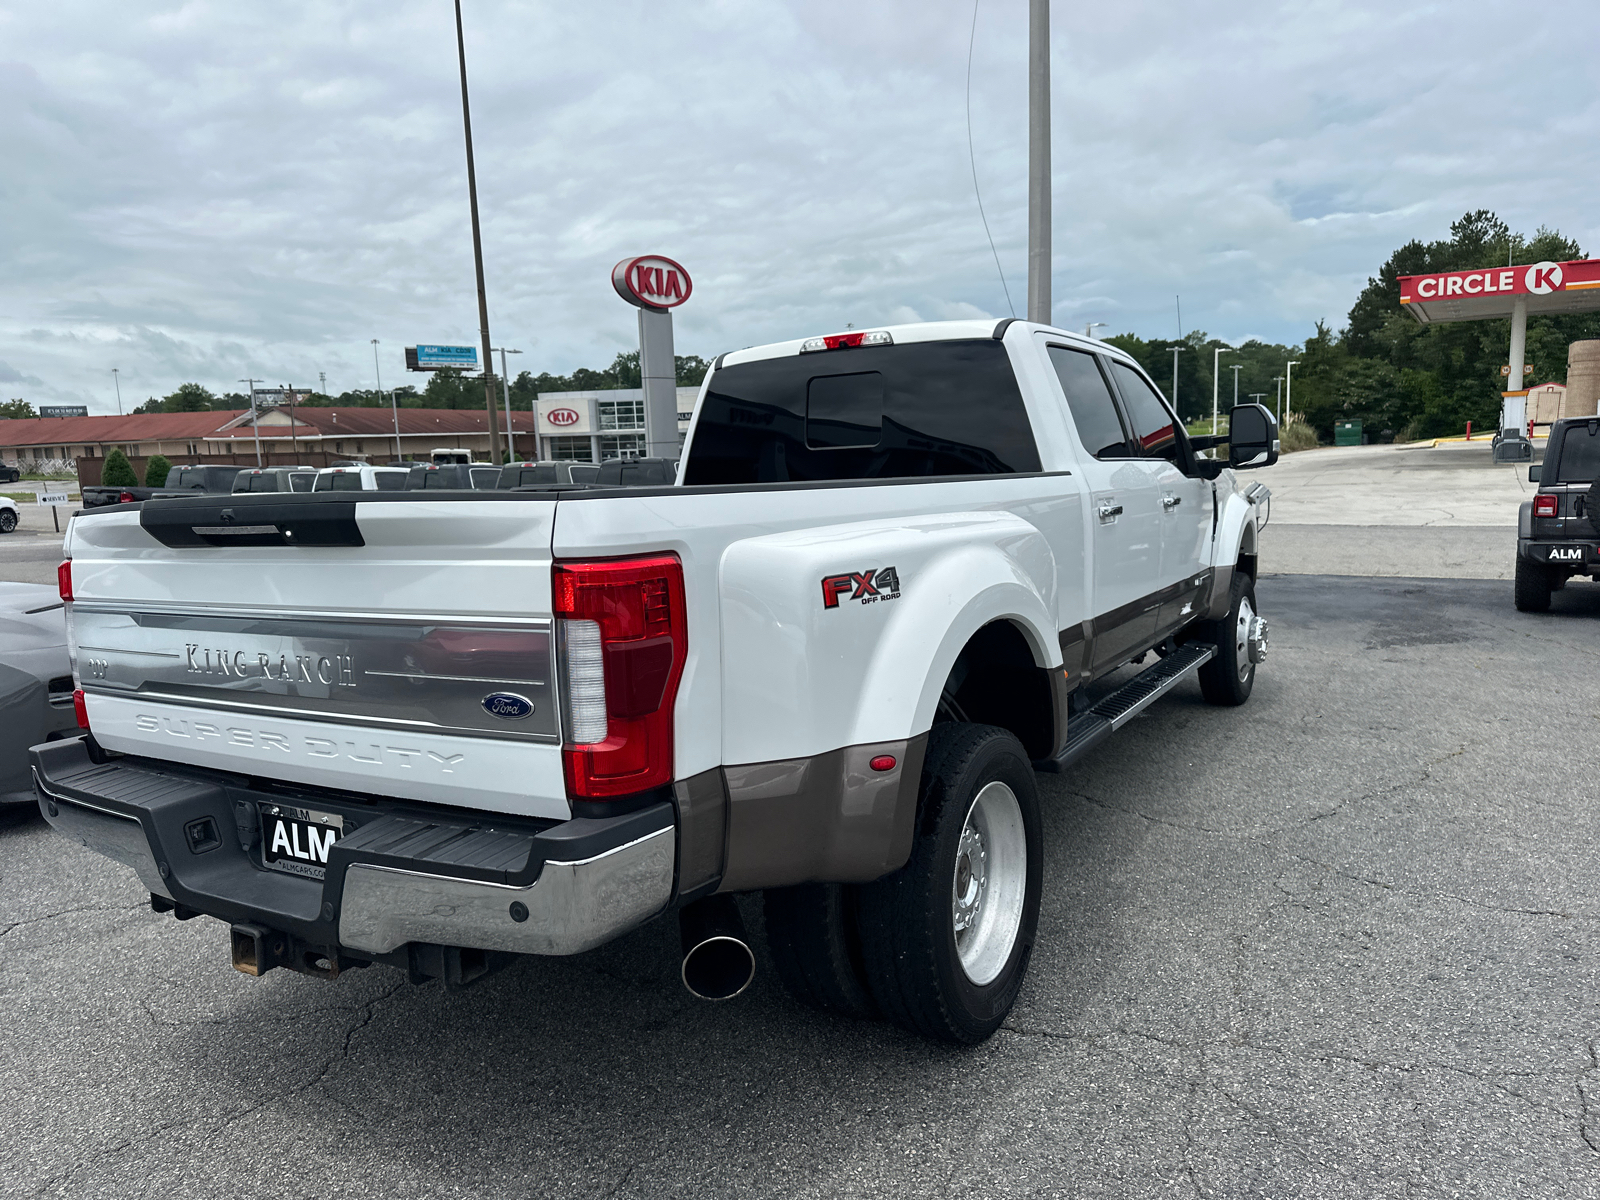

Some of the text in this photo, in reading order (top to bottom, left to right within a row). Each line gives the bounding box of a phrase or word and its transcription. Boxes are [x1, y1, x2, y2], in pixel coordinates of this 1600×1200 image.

[636, 265, 683, 299] KIA
[1417, 267, 1559, 298] CIRCLE K
[552, 412, 574, 422] KIA
[1548, 548, 1582, 560] ALM
[821, 566, 900, 610] FX4
[861, 592, 901, 605] OFF ROAD
[185, 643, 357, 687] KING RANCH
[136, 714, 464, 773] SUPER DUTY
[289, 807, 311, 821] ALM
[271, 819, 336, 864] ALM
[282, 861, 325, 877] ALMCARS.CO
